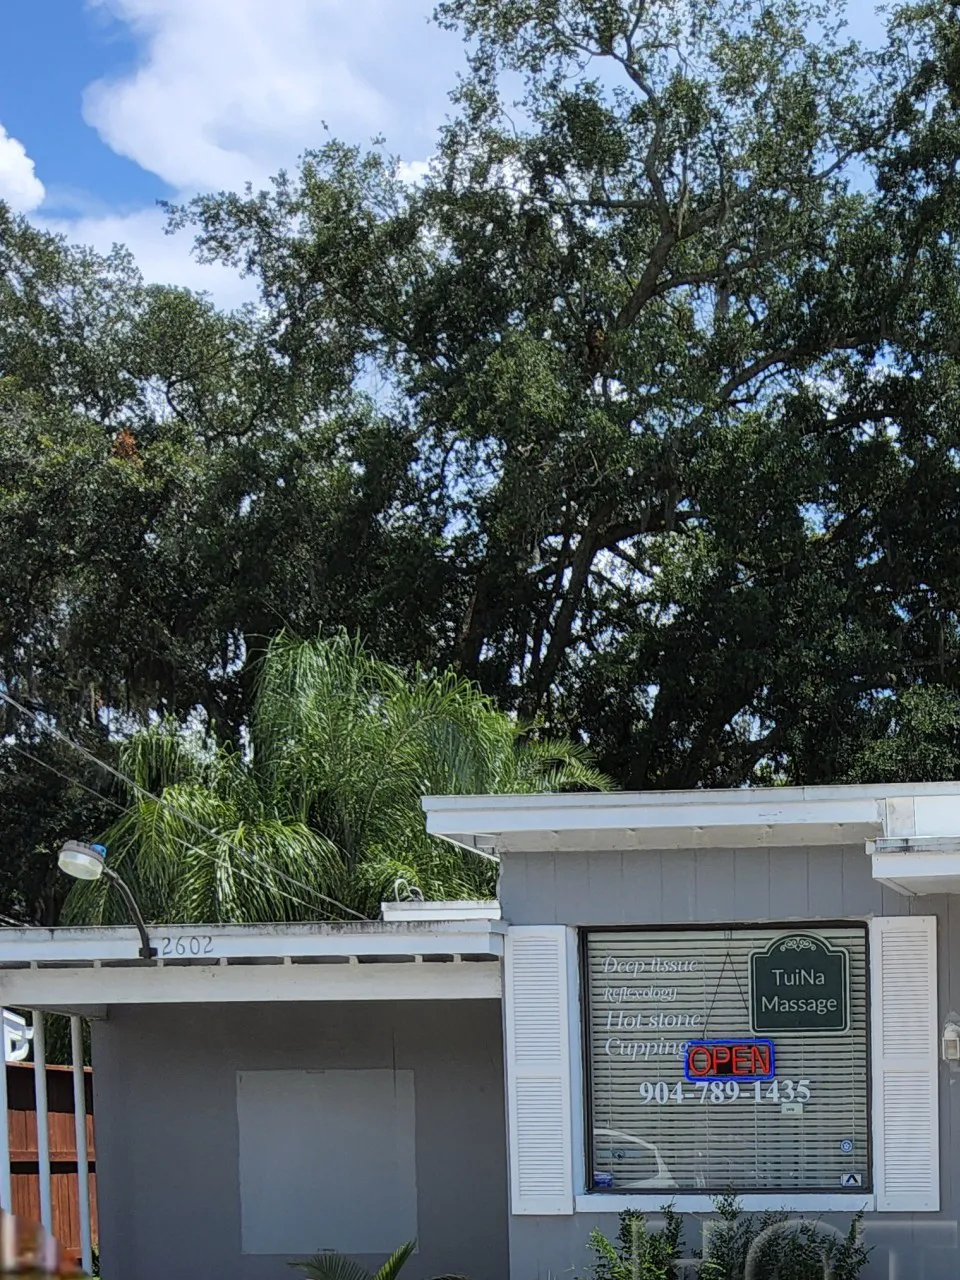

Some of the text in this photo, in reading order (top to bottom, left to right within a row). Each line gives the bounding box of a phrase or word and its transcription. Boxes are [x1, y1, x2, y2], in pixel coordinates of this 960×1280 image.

[162, 936, 214, 956] 2602
[601, 956, 698, 977] Deep tissue
[771, 968, 825, 986] TuiNa
[602, 986, 677, 1004] Reflexology
[761, 995, 837, 1015] Massage
[604, 1011, 701, 1030] Hot stone
[605, 1037, 691, 1061] Cupping
[688, 1046, 770, 1075] OPEN
[639, 1079, 811, 1104] 904-789-1435
